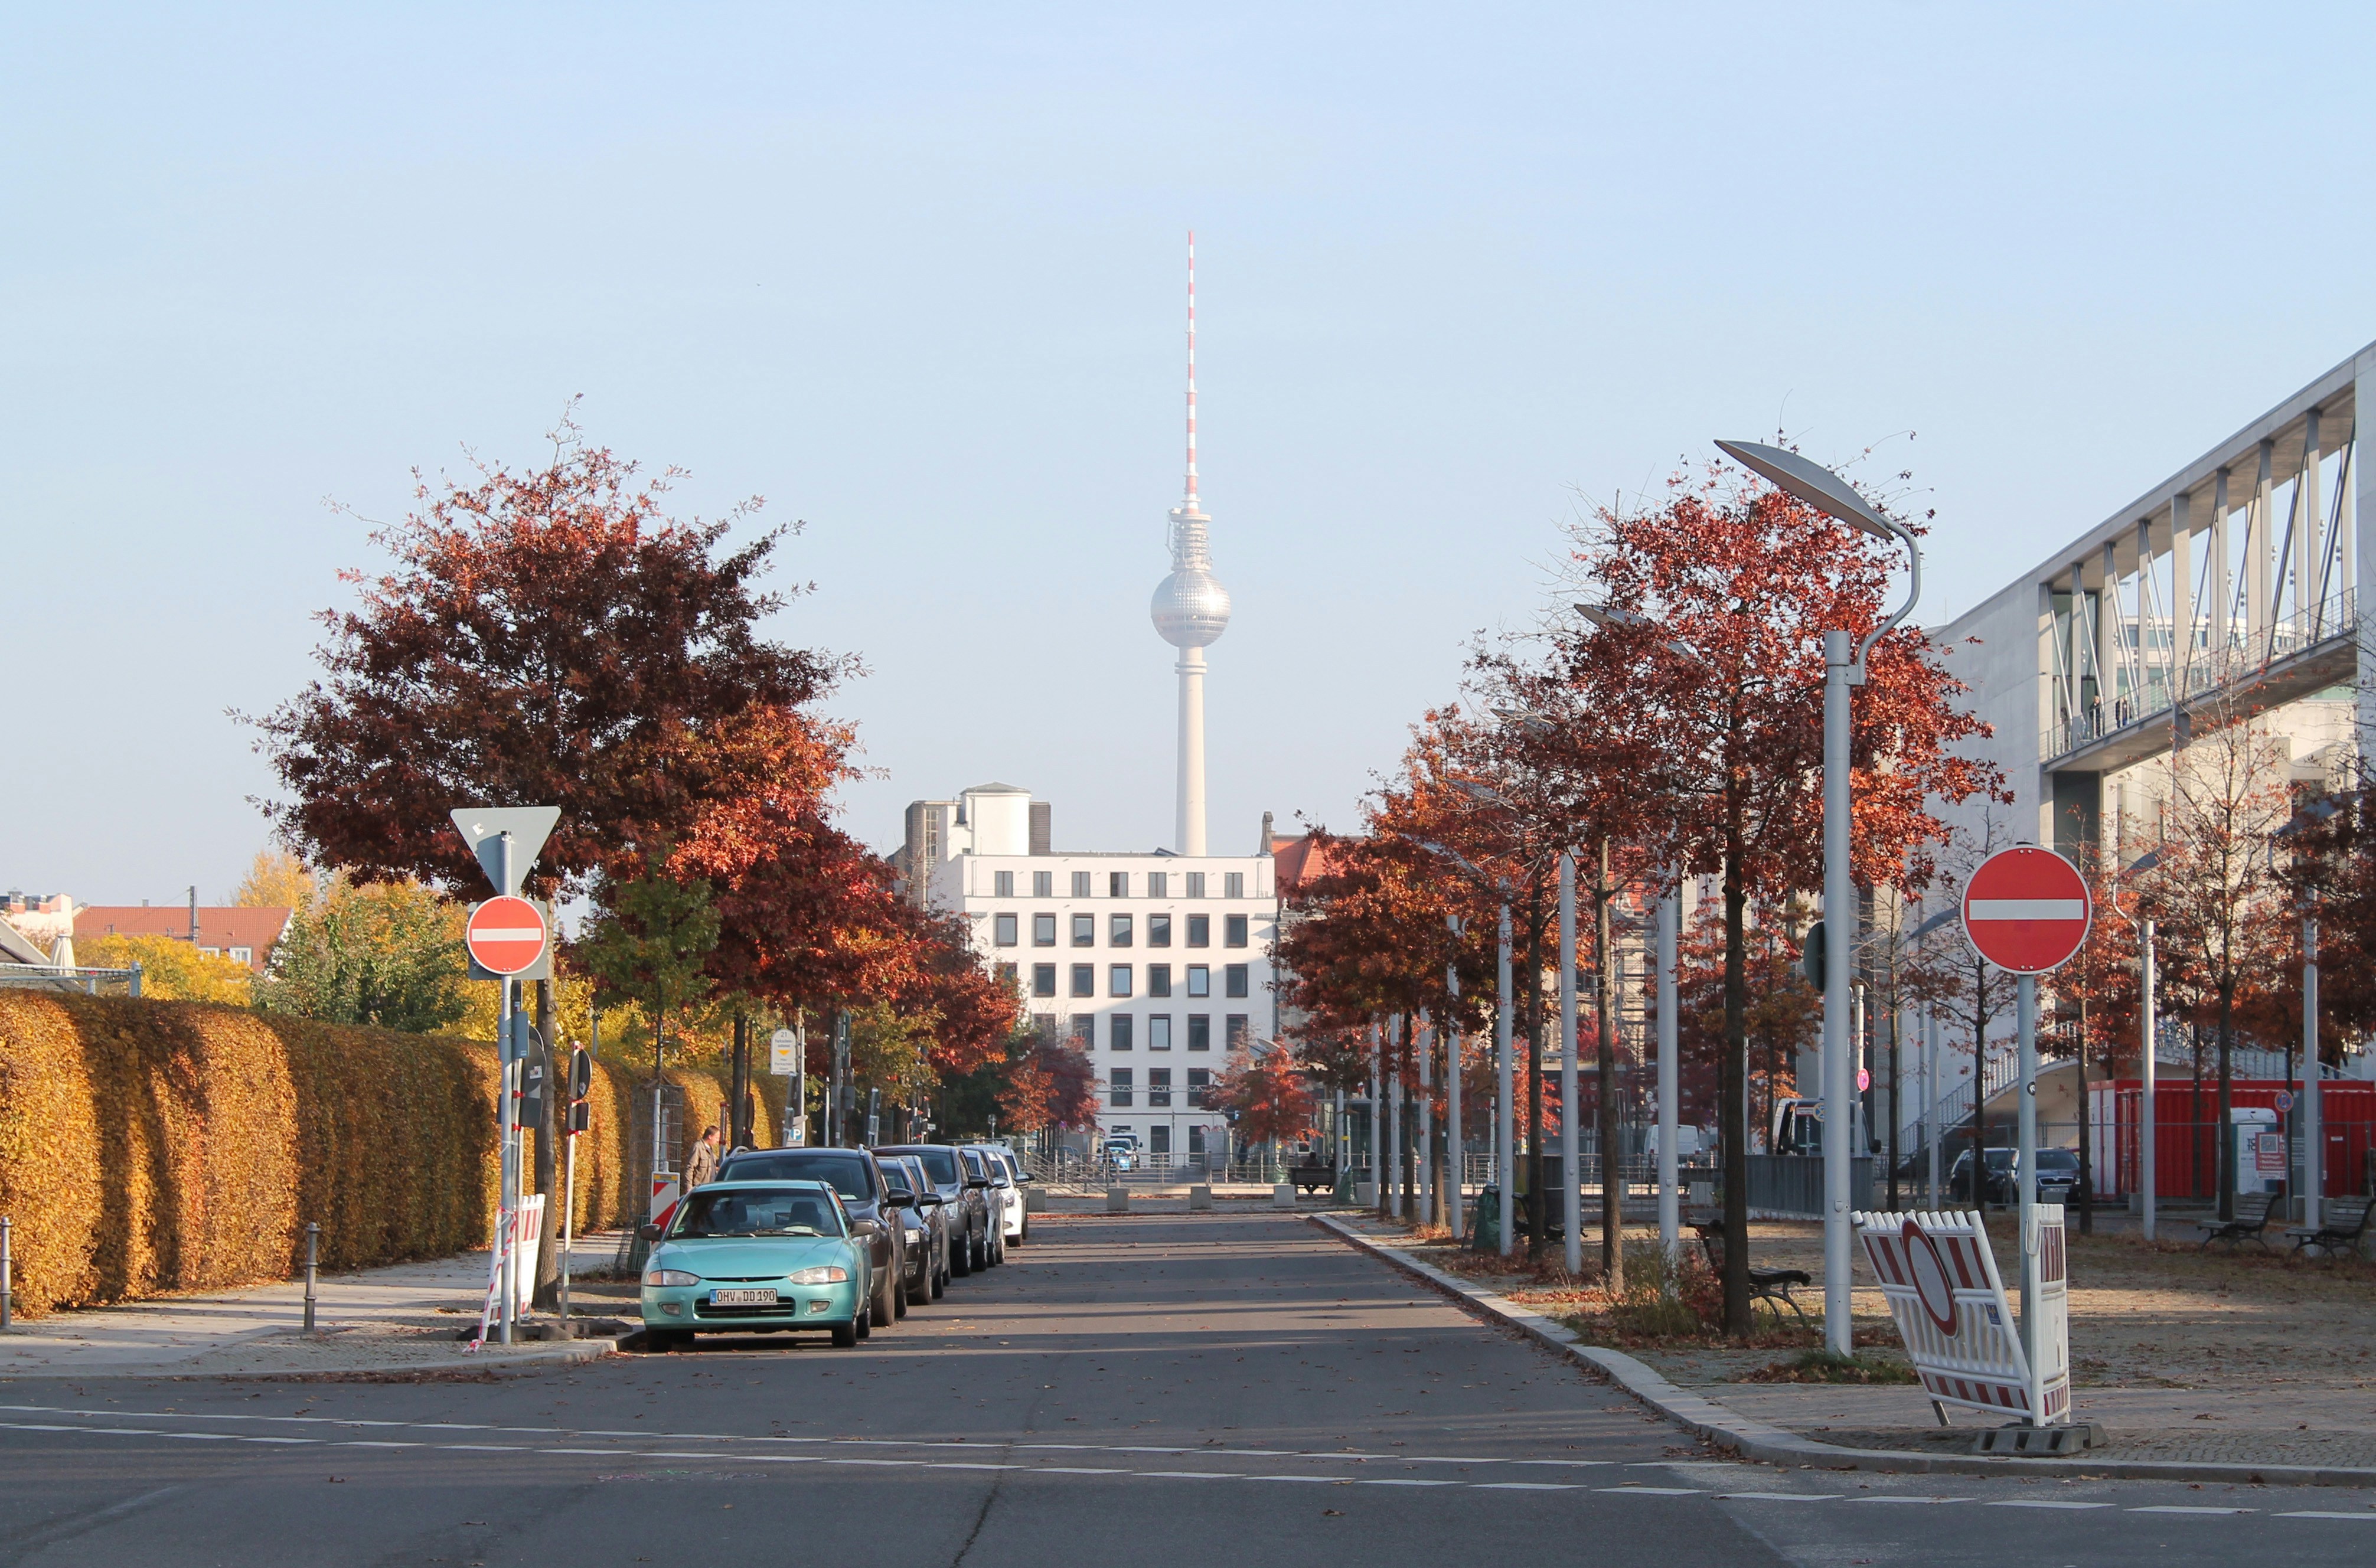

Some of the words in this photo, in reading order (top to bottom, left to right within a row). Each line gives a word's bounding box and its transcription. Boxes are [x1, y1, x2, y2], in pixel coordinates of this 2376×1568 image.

[794, 1129, 801, 1139] P
[717, 1291, 735, 1302] OHV
[743, 1291, 755, 1301] DD
[757, 1291, 775, 1301] 190
